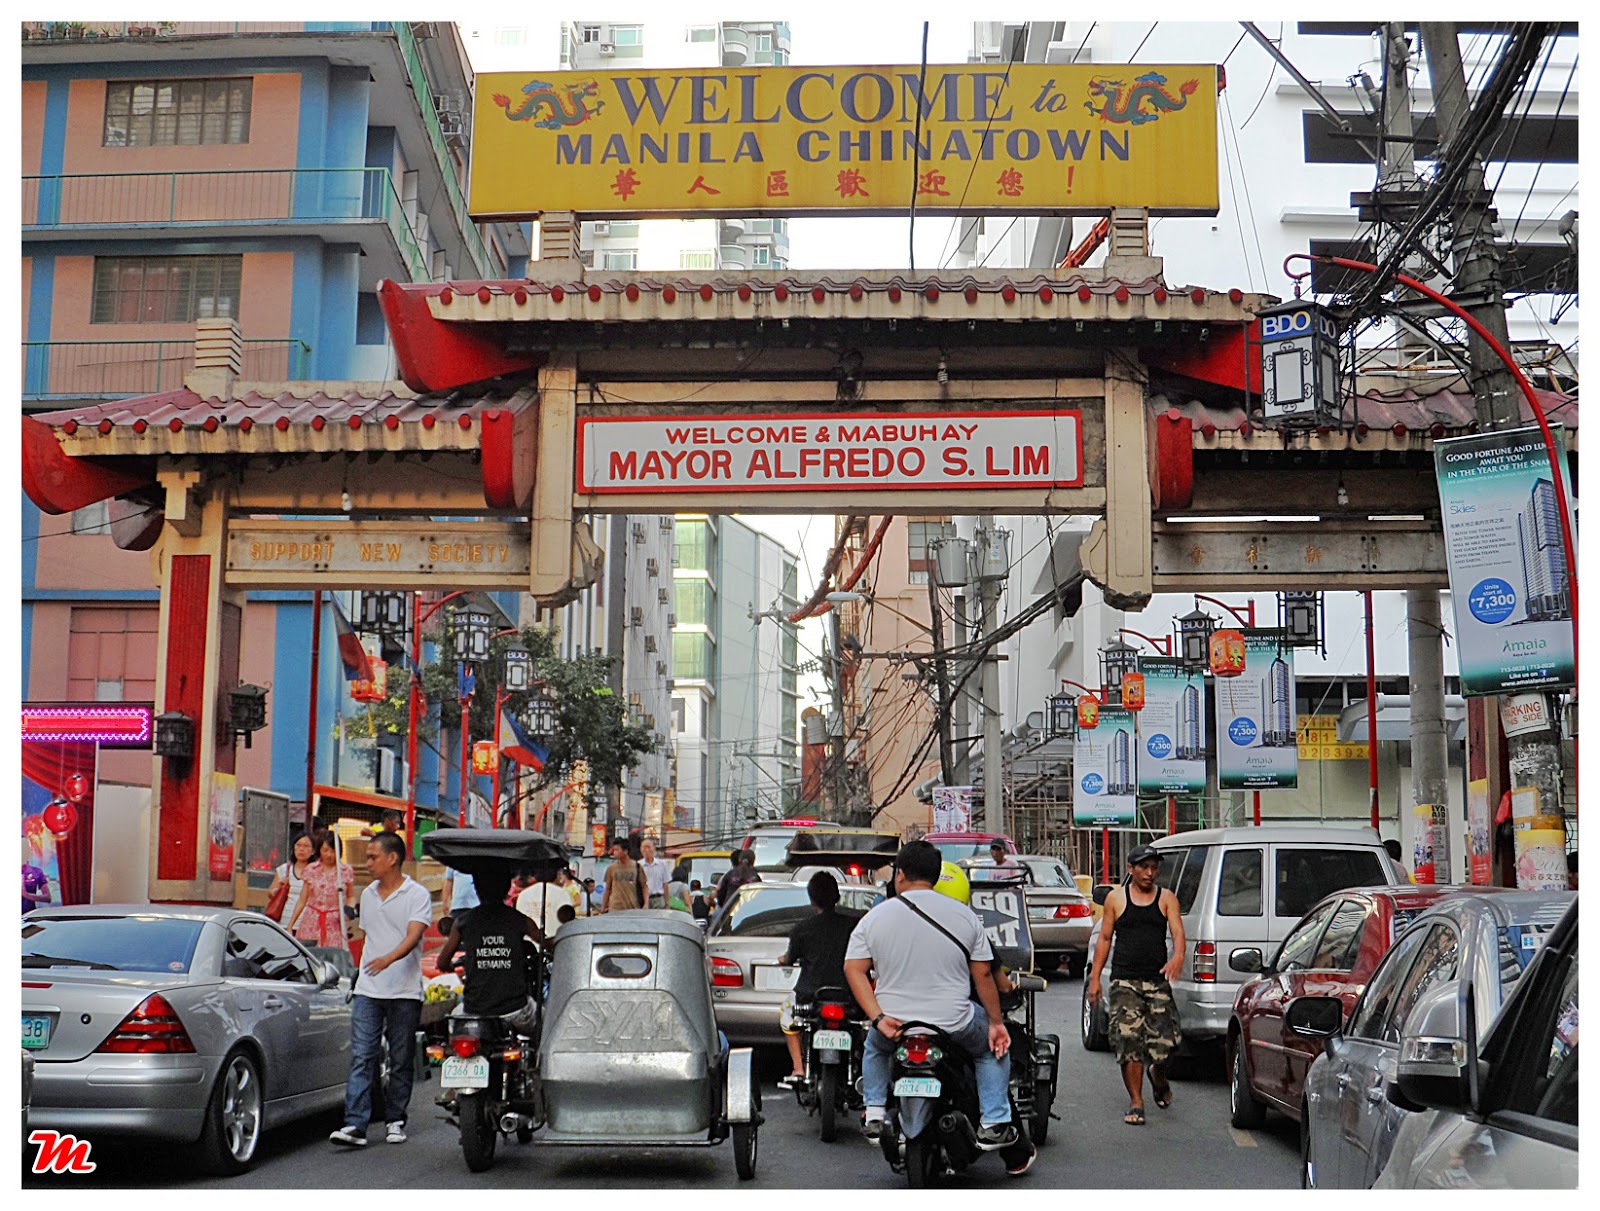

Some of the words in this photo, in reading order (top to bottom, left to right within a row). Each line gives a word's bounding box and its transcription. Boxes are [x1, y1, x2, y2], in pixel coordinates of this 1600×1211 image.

[610, 72, 1013, 126] WELCOME
[1030, 79, 1067, 113] to
[555, 131, 764, 165] MANILA
[797, 129, 1129, 162] CHINATOWN
[1263, 310, 1311, 336] BDO
[1320, 317, 1336, 339] DO
[665, 426, 807, 444] WELCOME
[815, 425, 830, 443] &
[838, 424, 978, 442] MABUHAY
[609, 450, 733, 480] MAYOR
[746, 447, 926, 478] ALFREDO
[942, 446, 976, 477] S.
[985, 445, 1050, 476] LIM
[1446, 453, 1473, 463] GOOD
[1474, 447, 1512, 459] FORTUNE
[1513, 444, 1532, 454] AND
[1479, 456, 1504, 466] AWAIT
[1505, 454, 1524, 462] YOU
[1447, 470, 1458, 479] IN
[1459, 468, 1476, 477] THE
[1476, 465, 1498, 475] YEAR
[1499, 463, 1511, 471] OF
[1511, 460, 1529, 470] THE
[1450, 504, 1477, 515] Skies
[250, 542, 335, 561] SUPPORT
[360, 543, 402, 562] NEW
[428, 544, 509, 563] SOCIETY
[1502, 638, 1547, 652] Amaia
[1522, 712, 1543, 722] SIDE
[971, 891, 1020, 919] GO
[482, 936, 505, 946] YOUR
[476, 948, 512, 957] MEMORY
[477, 960, 511, 969] REMAINS
[561, 1000, 673, 1044] SYM
